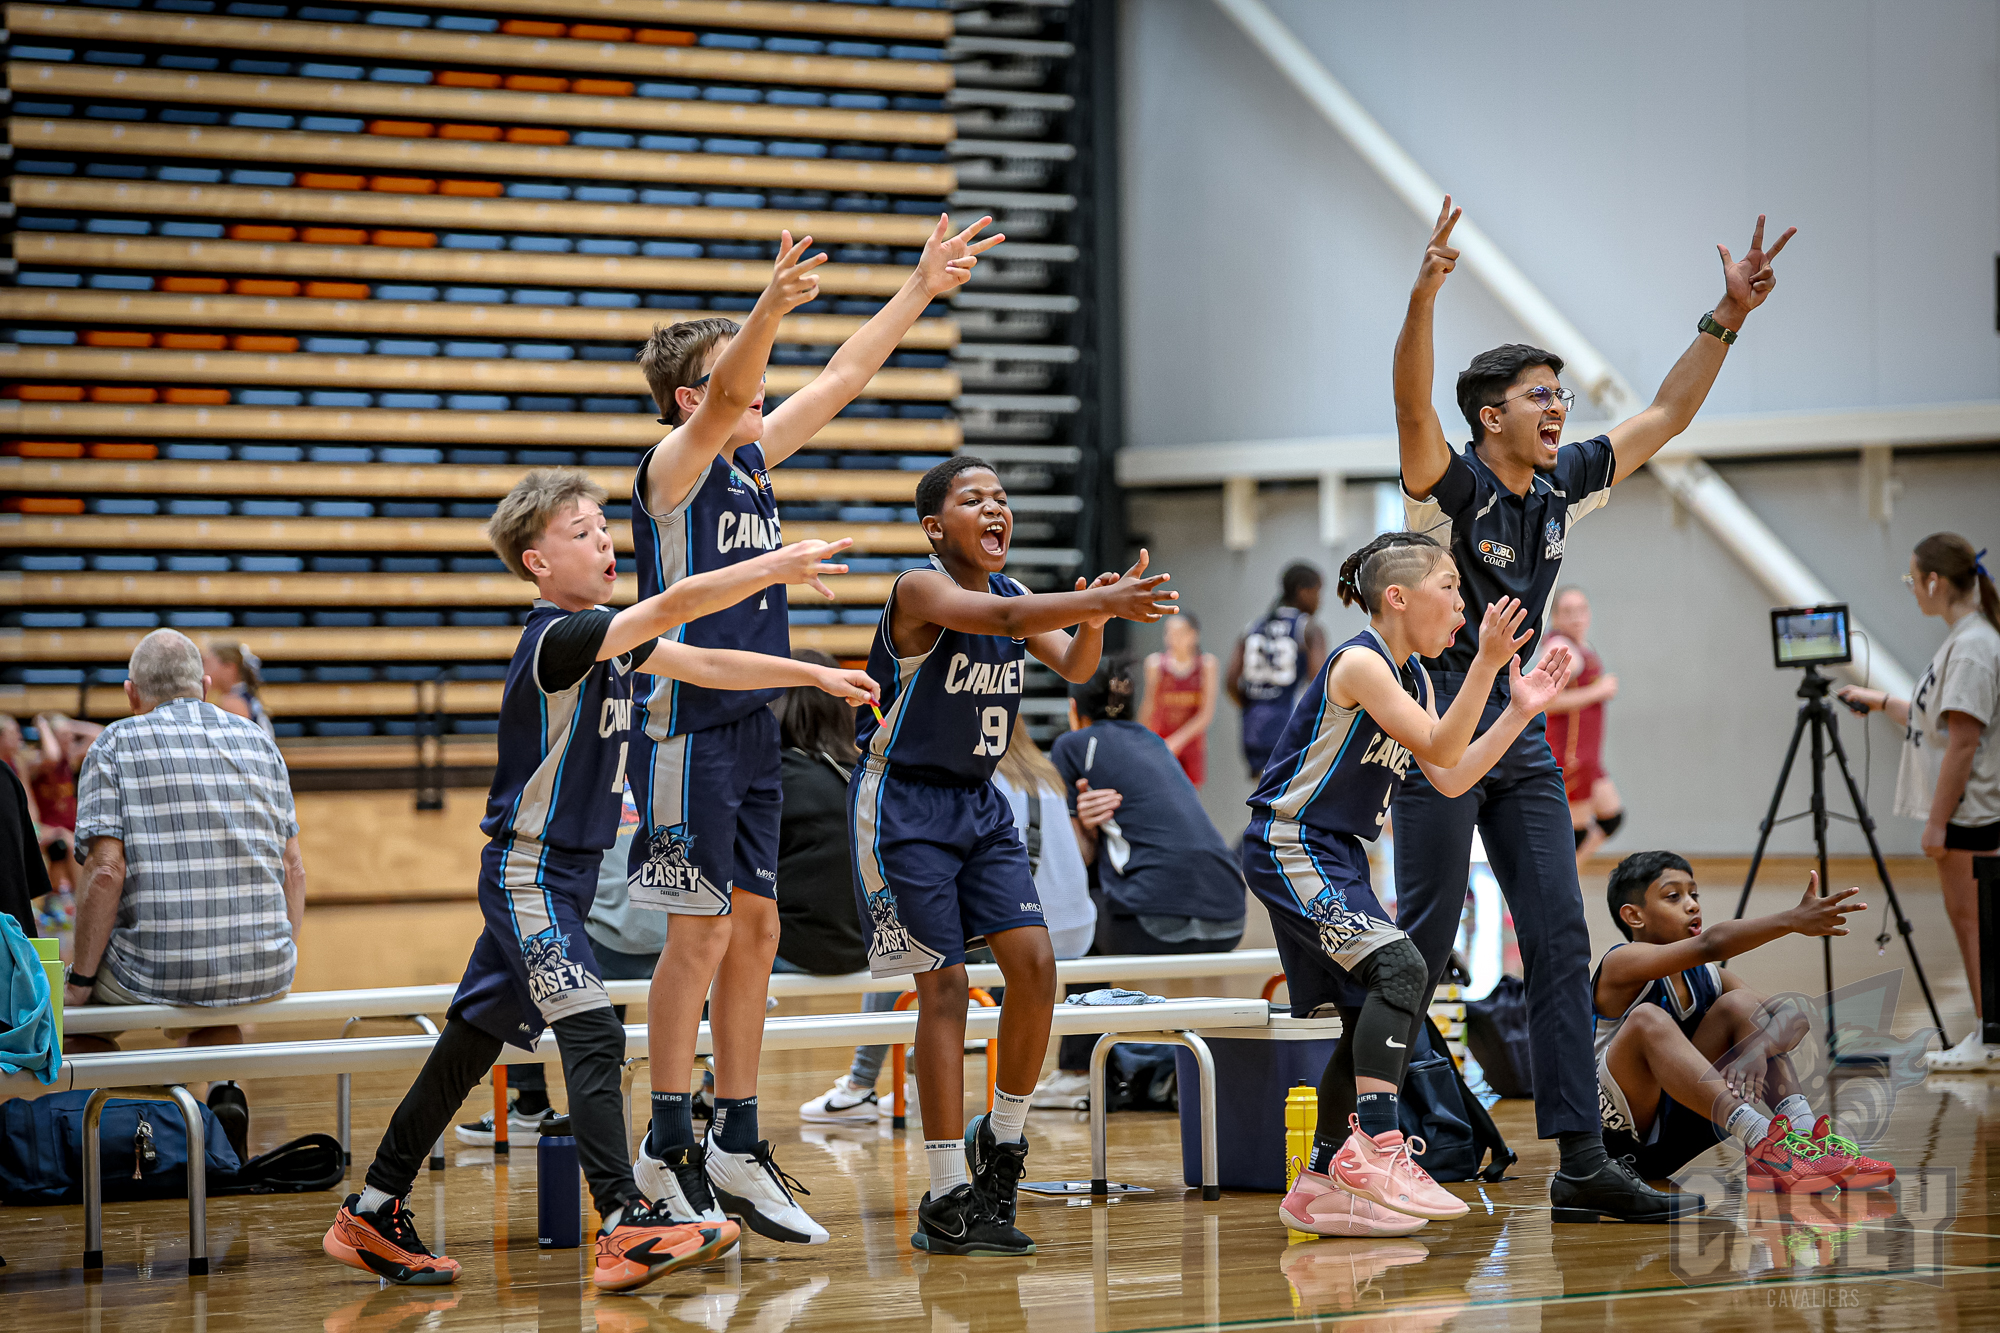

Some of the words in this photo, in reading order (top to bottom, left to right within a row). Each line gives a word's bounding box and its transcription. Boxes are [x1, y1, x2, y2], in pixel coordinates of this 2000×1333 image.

[1545, 540, 1564, 560] CASE
[640, 862, 700, 891] CASEY
[873, 928, 911, 955] CASEY
[1320, 912, 1373, 954] CASEY
[528, 963, 586, 1002] CASEY
